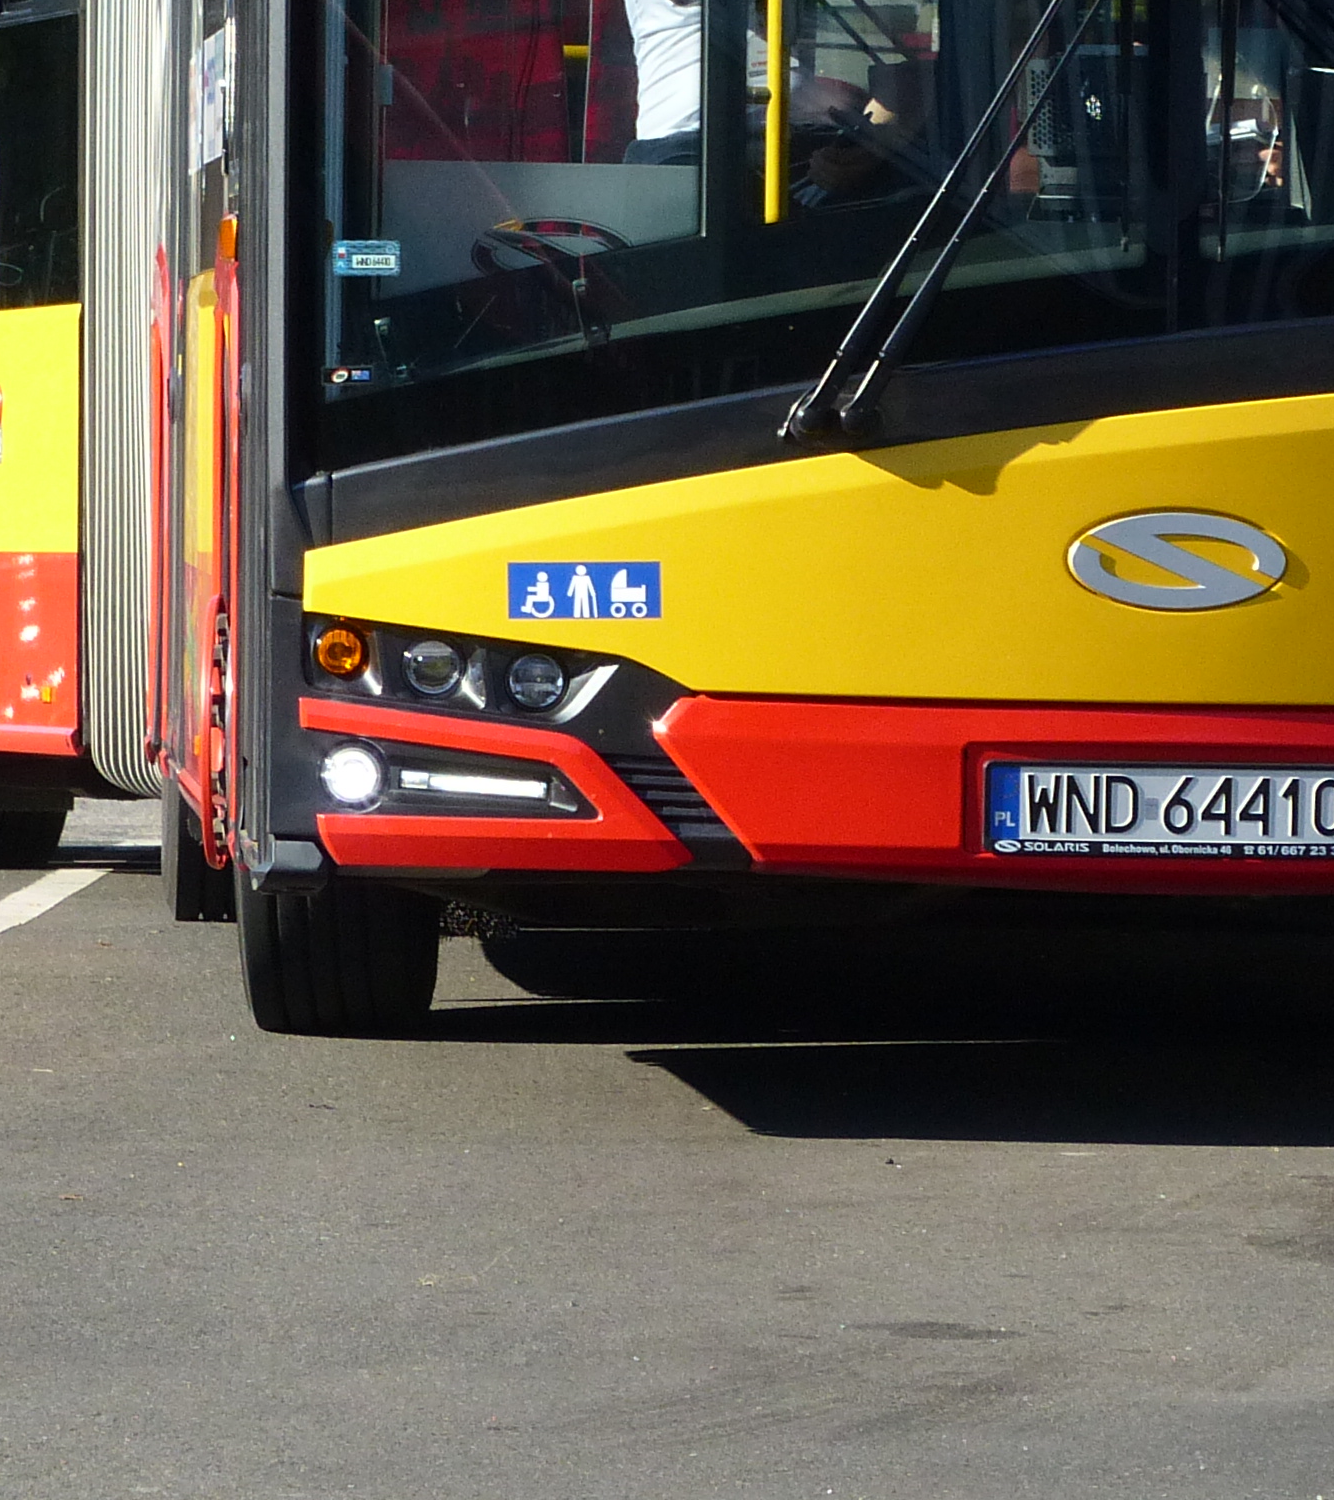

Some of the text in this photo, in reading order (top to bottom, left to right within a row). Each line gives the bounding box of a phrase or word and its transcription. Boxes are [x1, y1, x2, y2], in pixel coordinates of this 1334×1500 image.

[1024, 773, 1140, 835] WND
[994, 811, 1016, 827] PL
[1023, 841, 1090, 853] SOLARIS
[1102, 843, 1159, 856] Bolechowo,
[1171, 844, 1218, 855] Obornicka
[1310, 846, 1327, 857] 23
